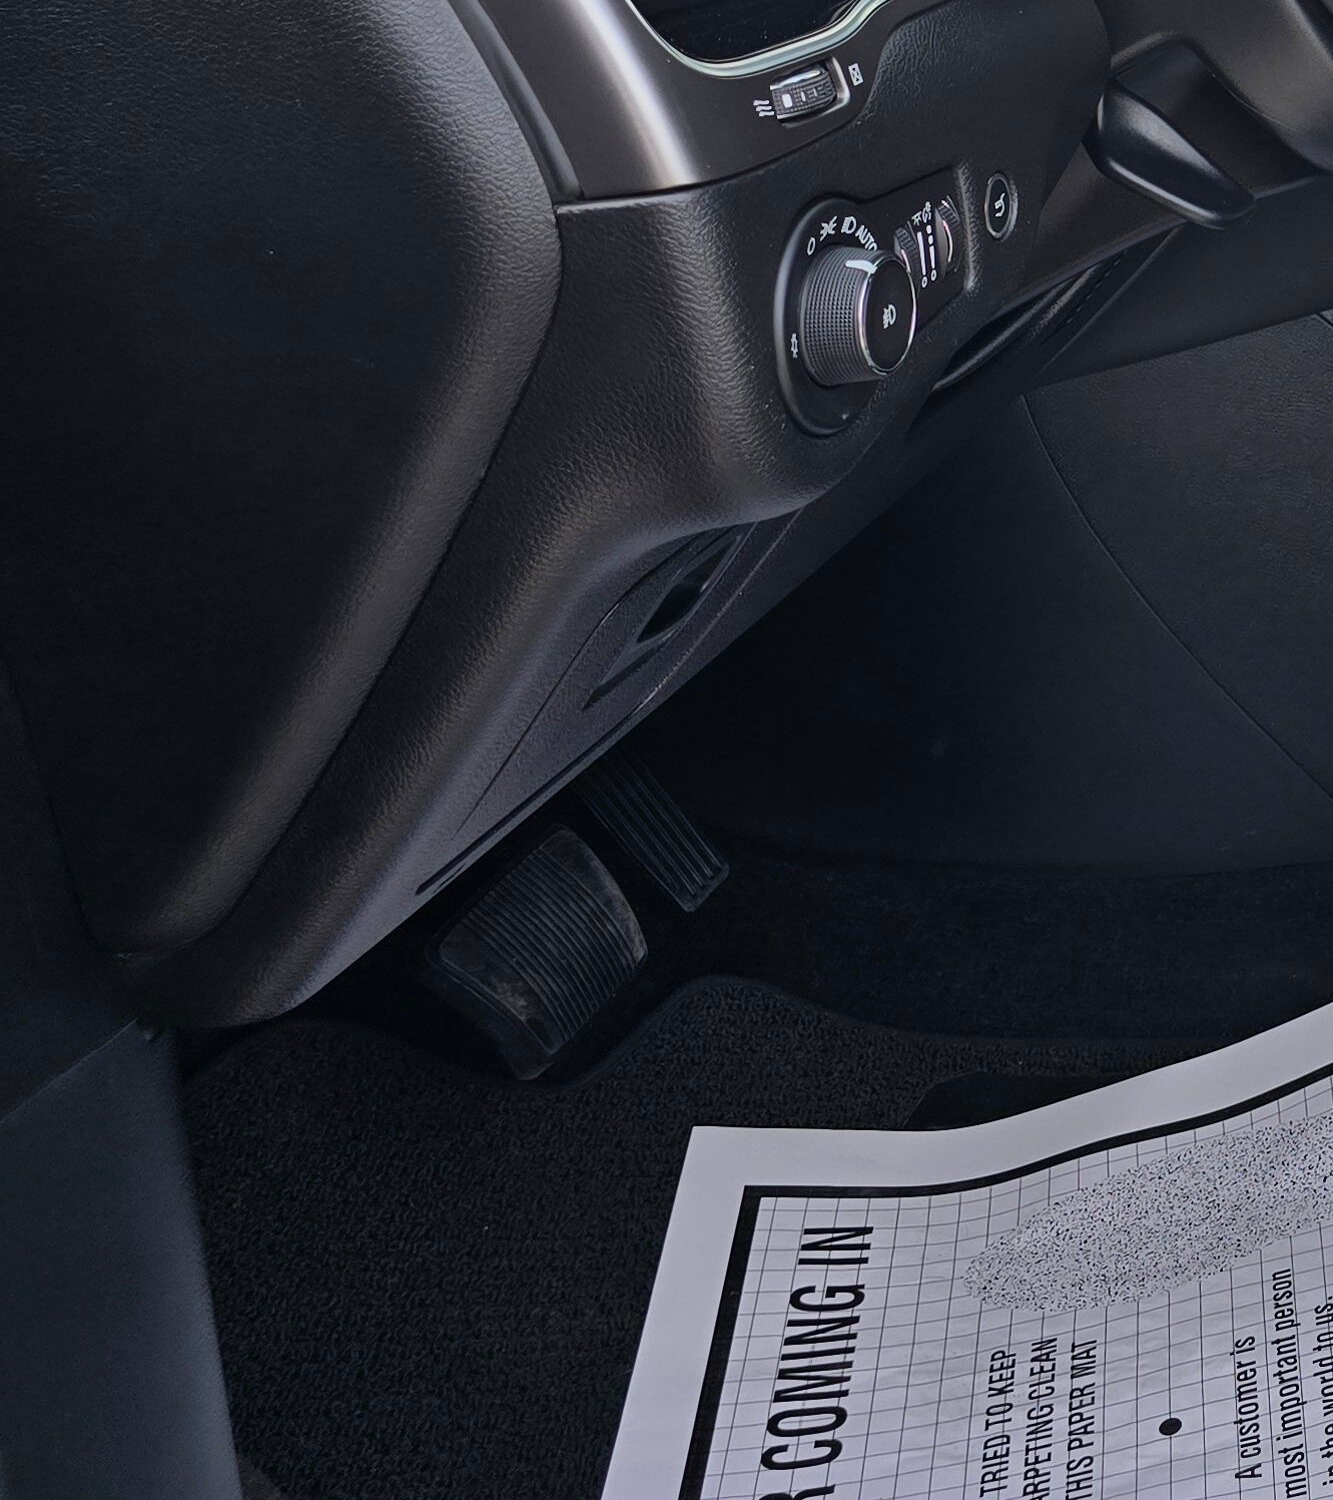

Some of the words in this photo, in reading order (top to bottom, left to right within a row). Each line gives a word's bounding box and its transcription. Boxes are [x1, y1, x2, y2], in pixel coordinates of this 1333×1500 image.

[854, 224, 879, 251] AUTO
[798, 1226, 875, 1266] IN
[1272, 1268, 1301, 1332] person
[1028, 1337, 1058, 1401] CLEAN
[1070, 1340, 1097, 1380] MAT
[1229, 1336, 1256, 1357] is
[760, 1284, 866, 1471] COMING
[987, 1350, 1017, 1398] KEEP
[1271, 1334, 1307, 1442] important
[984, 1402, 1013, 1432] TO
[1067, 1382, 1096, 1451] PAPER
[1233, 1361, 1262, 1459] customer
[979, 1434, 1011, 1498] TRIED
[1065, 1455, 1094, 1500] THIS
[1234, 1463, 1262, 1479] A
[1278, 1443, 1307, 1499] most
